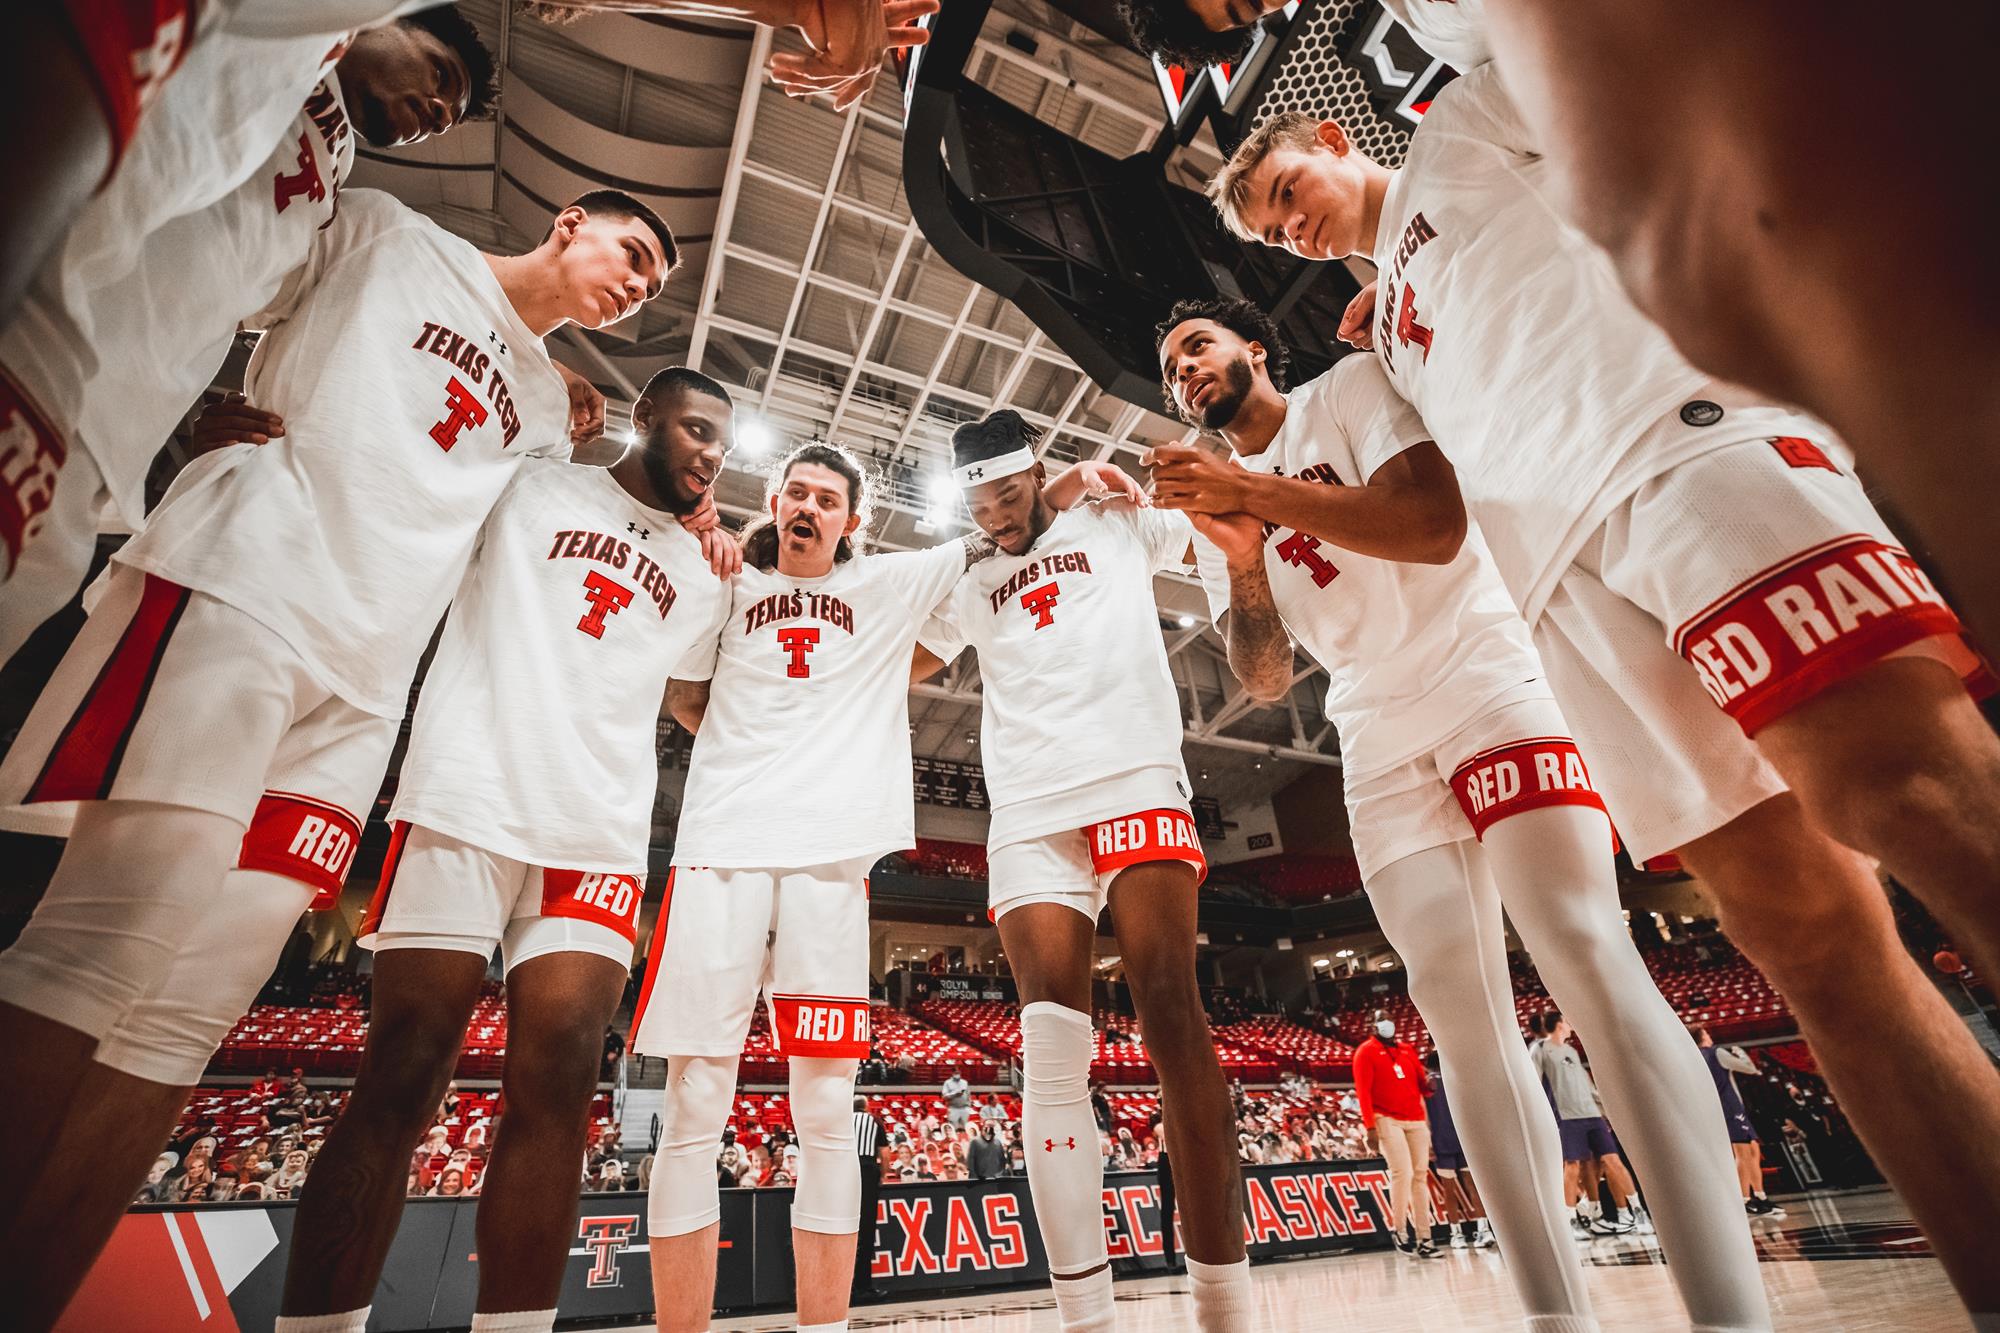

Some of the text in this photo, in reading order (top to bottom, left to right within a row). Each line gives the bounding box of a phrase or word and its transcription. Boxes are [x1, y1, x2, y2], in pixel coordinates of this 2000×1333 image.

[1393, 211, 1439, 281] TECH
[411, 321, 522, 449] TEXAS TECH
[547, 530, 678, 621] TEXAS TECH
[989, 551, 1093, 616] TEXAS TECH
[745, 593, 854, 636] TEXAS TECH
[1467, 760, 1521, 815] RED
[287, 814, 351, 874] RED
[1096, 818, 1147, 856] RED
[573, 871, 634, 917] RED
[795, 1005, 845, 1042] RED
